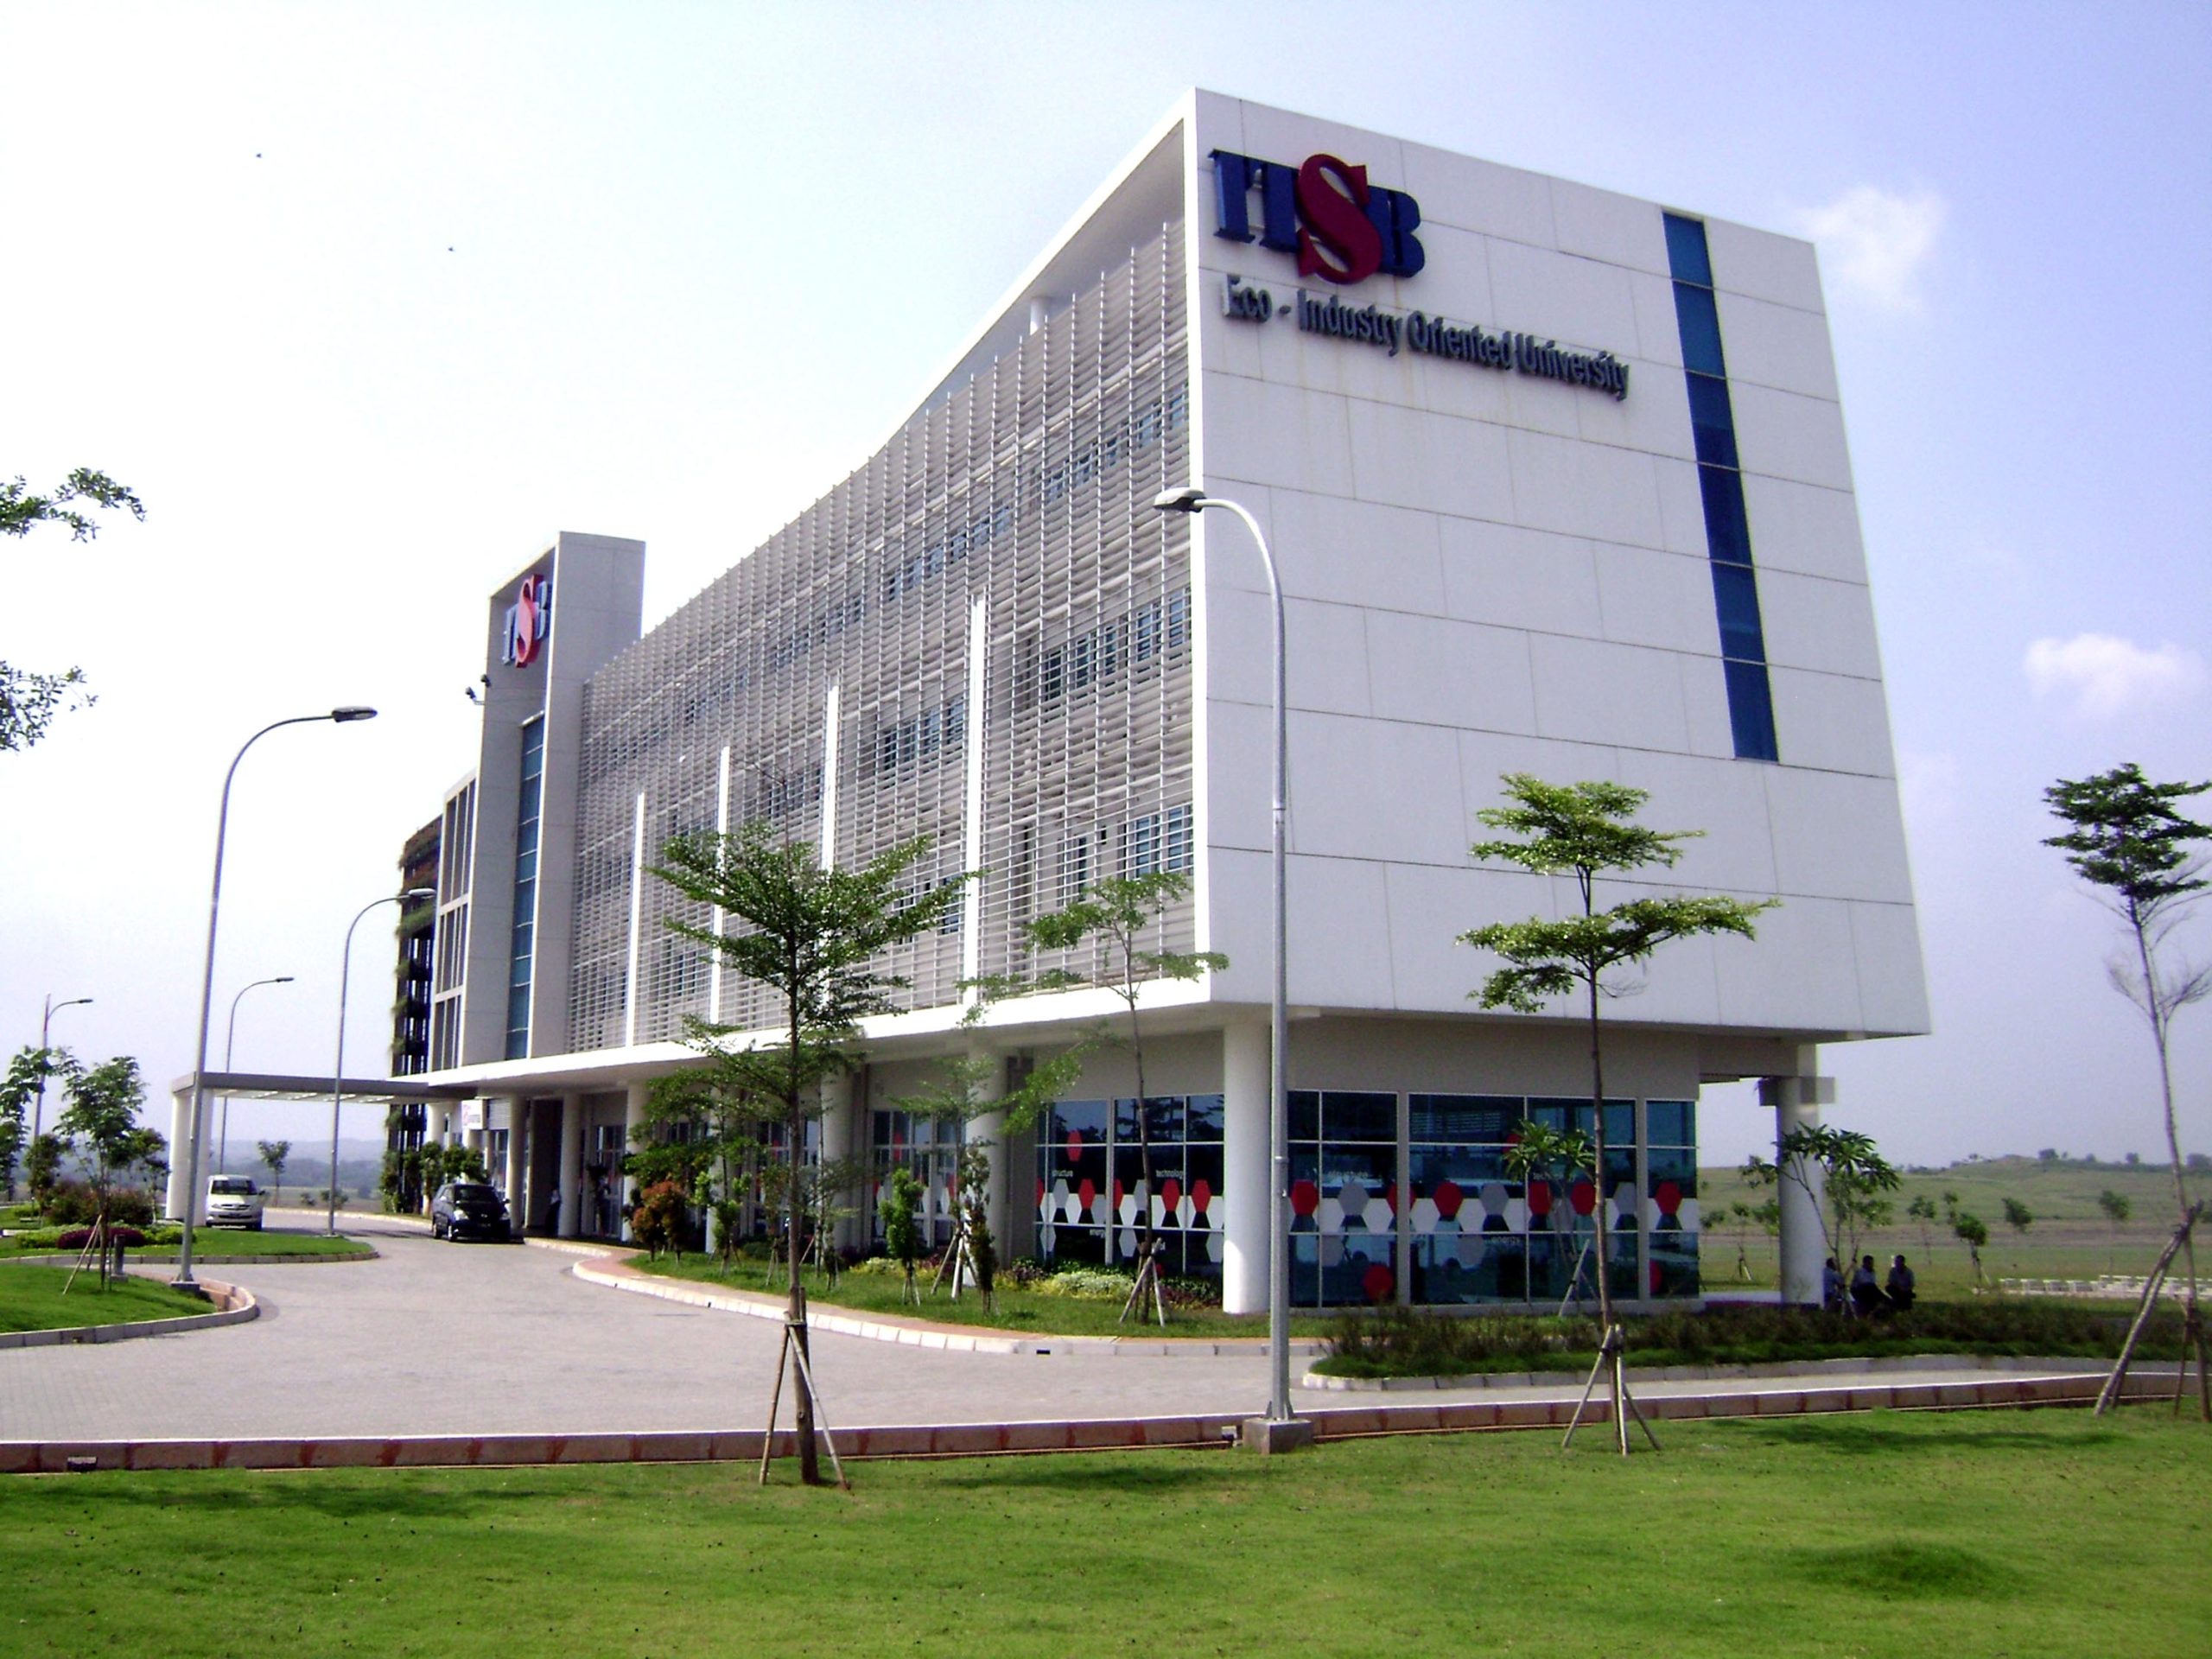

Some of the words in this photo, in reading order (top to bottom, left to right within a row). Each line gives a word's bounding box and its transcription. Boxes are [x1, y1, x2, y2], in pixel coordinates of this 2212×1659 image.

[1223, 274, 1272, 323] Eco
[1297, 288, 1402, 357] Industry
[1407, 310, 1511, 371] Oriented
[1516, 333, 1629, 401] University
[1155, 1169, 1184, 1180] technolog
